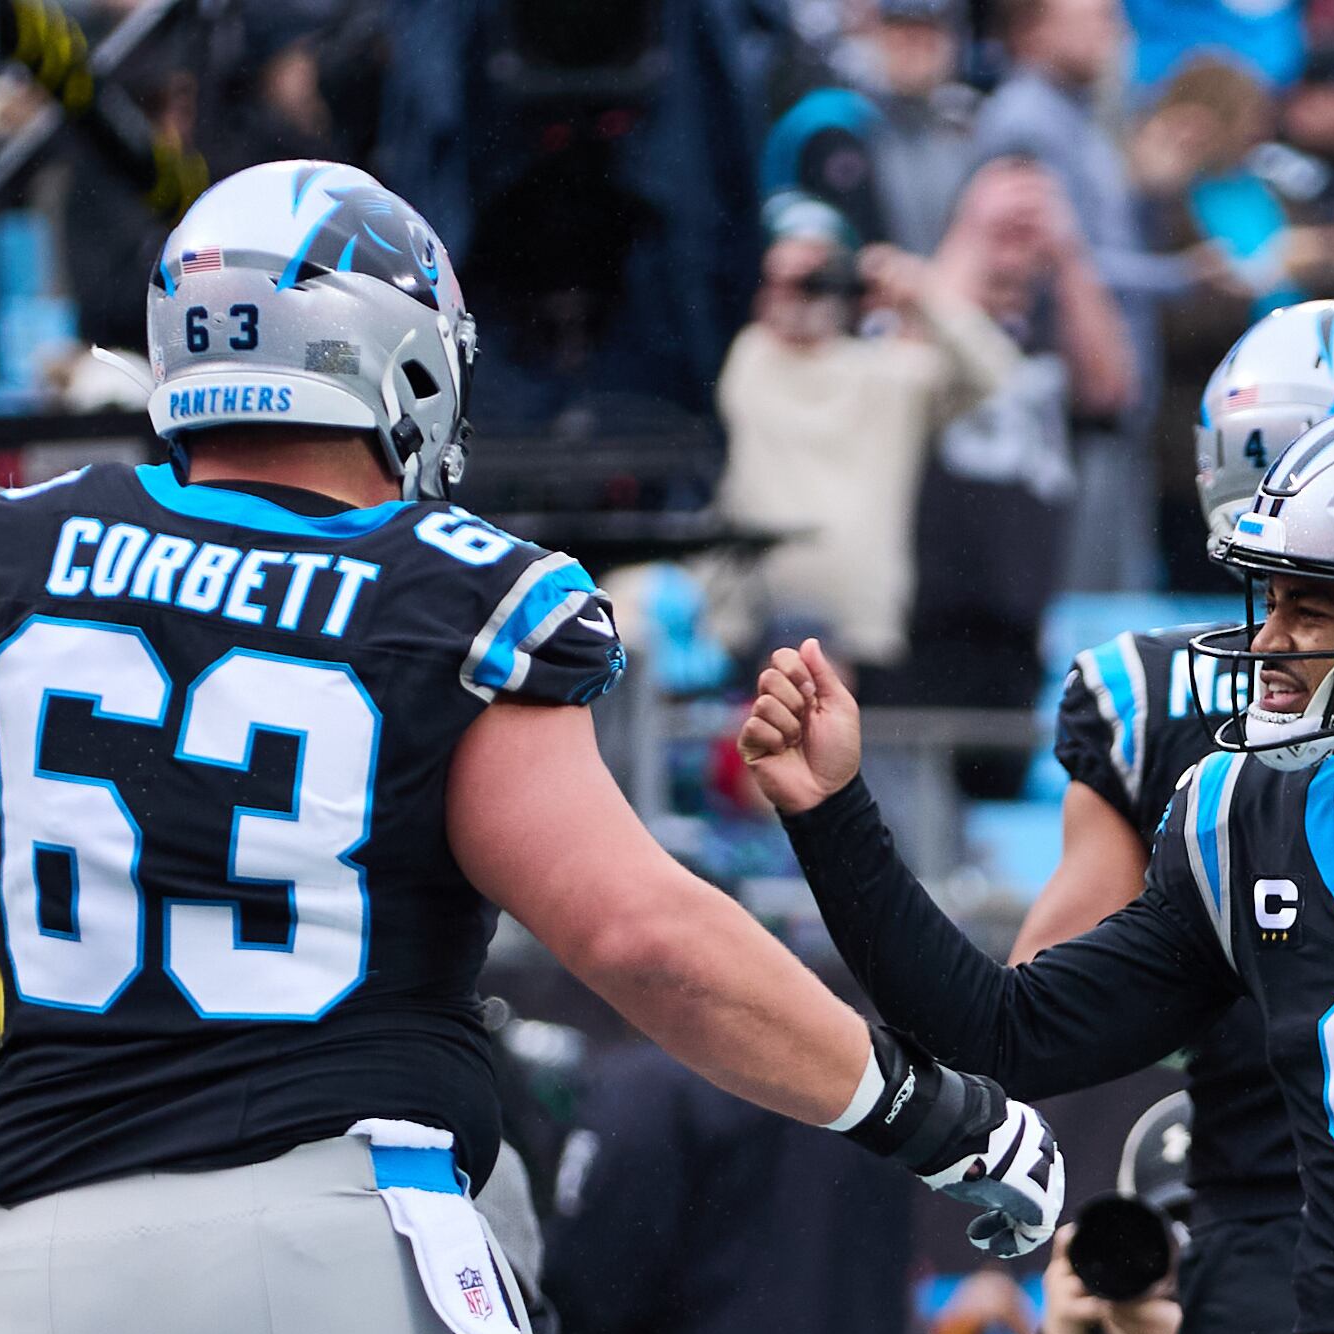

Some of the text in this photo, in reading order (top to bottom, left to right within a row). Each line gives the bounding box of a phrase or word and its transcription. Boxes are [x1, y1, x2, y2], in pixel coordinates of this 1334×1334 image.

[186, 303, 259, 353] 63
[170, 387, 293, 420] PANTHERS
[1244, 429, 1267, 468] 4
[46, 516, 381, 637] CORBETT
[1254, 877, 1299, 930] C
